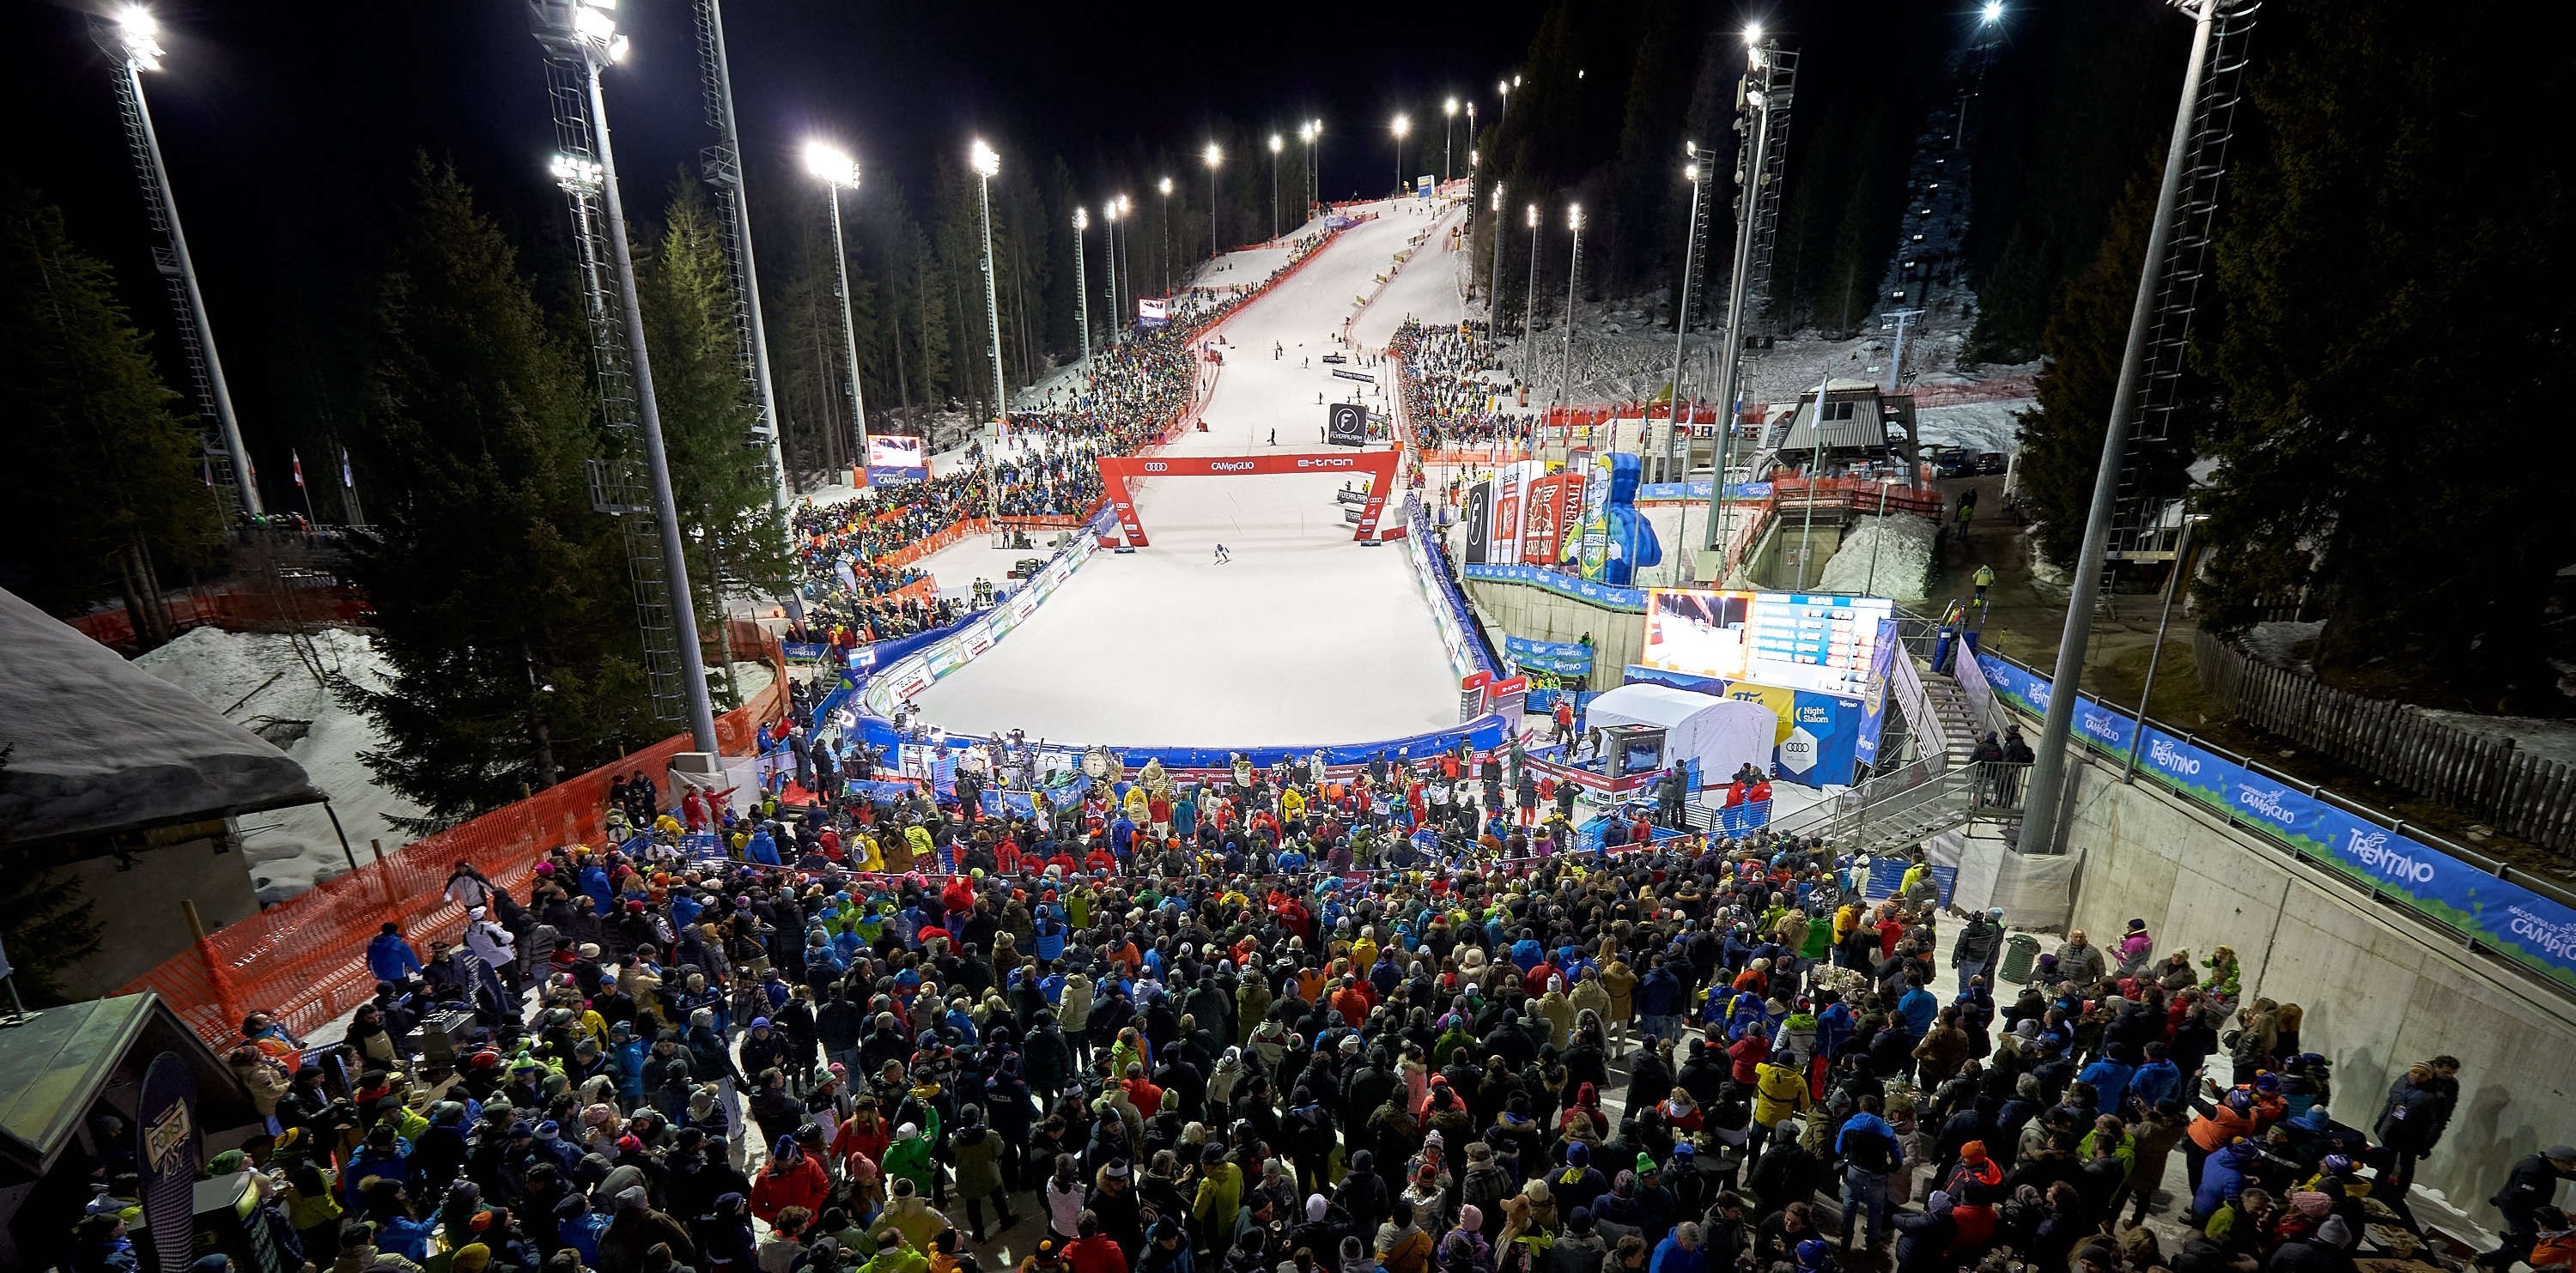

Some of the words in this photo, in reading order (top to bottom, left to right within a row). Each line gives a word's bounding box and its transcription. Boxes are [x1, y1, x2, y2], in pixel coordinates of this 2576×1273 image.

[1330, 432, 1364, 441] FLYERALARM
[1212, 461, 1255, 471] CAMPIGLIO
[1297, 458, 1354, 467] e-tron
[1584, 536, 1606, 544] ELEPAS
[2029, 682, 2050, 708] TRENTI
[1803, 706, 1825, 716] Night
[1803, 714, 1829, 724] Slalom
[2085, 718, 2120, 742] CAMPIGLIO
[2150, 739, 2200, 776] TRENTINO
[2240, 791, 2294, 824] CAMPIGLIO
[2347, 827, 2435, 883] TRENTINO
[2507, 905, 2549, 929] MADONNA
[2549, 924, 2559, 933] DI
[2511, 918, 2576, 961] CAMPIG
